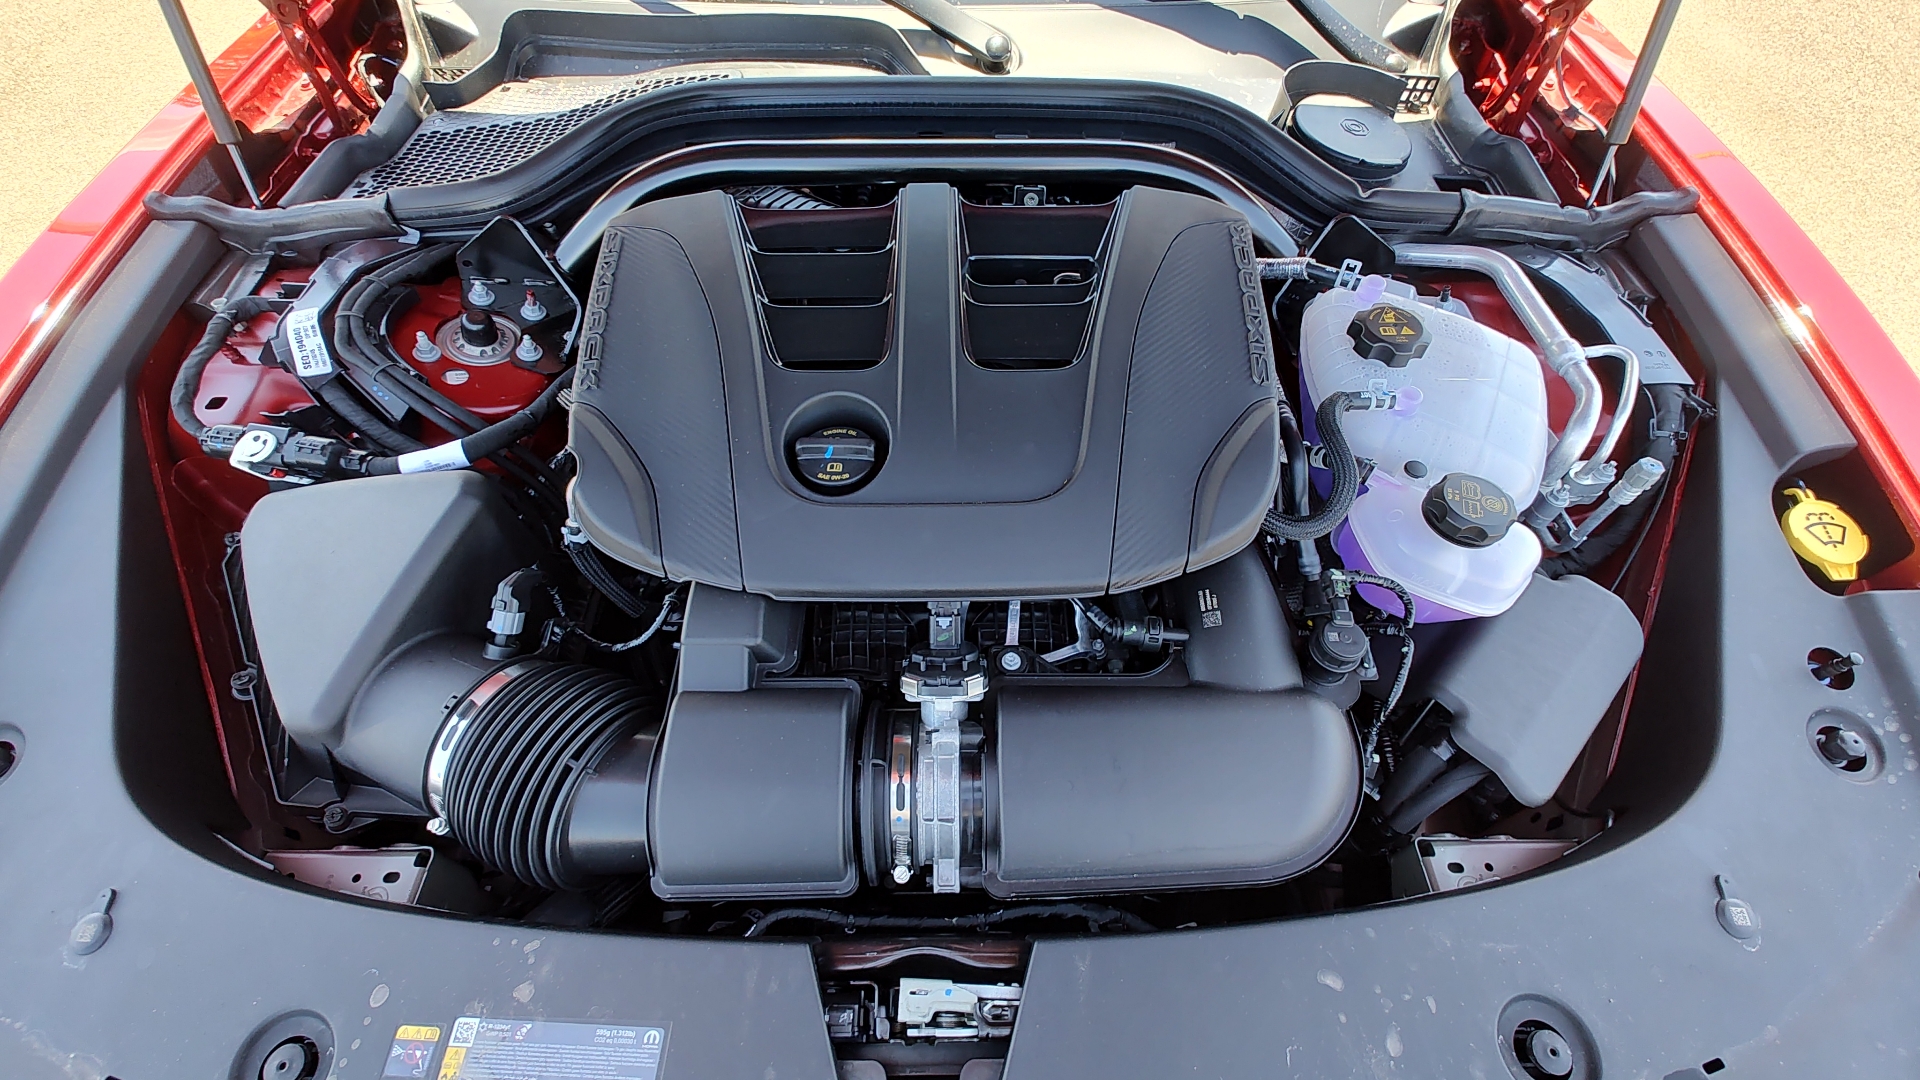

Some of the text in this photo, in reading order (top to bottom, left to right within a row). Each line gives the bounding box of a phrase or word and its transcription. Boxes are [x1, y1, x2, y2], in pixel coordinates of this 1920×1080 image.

[578, 231, 622, 391] SIXPACK
[1229, 223, 1271, 386] SIXPACK
[847, 429, 857, 437] OIL
